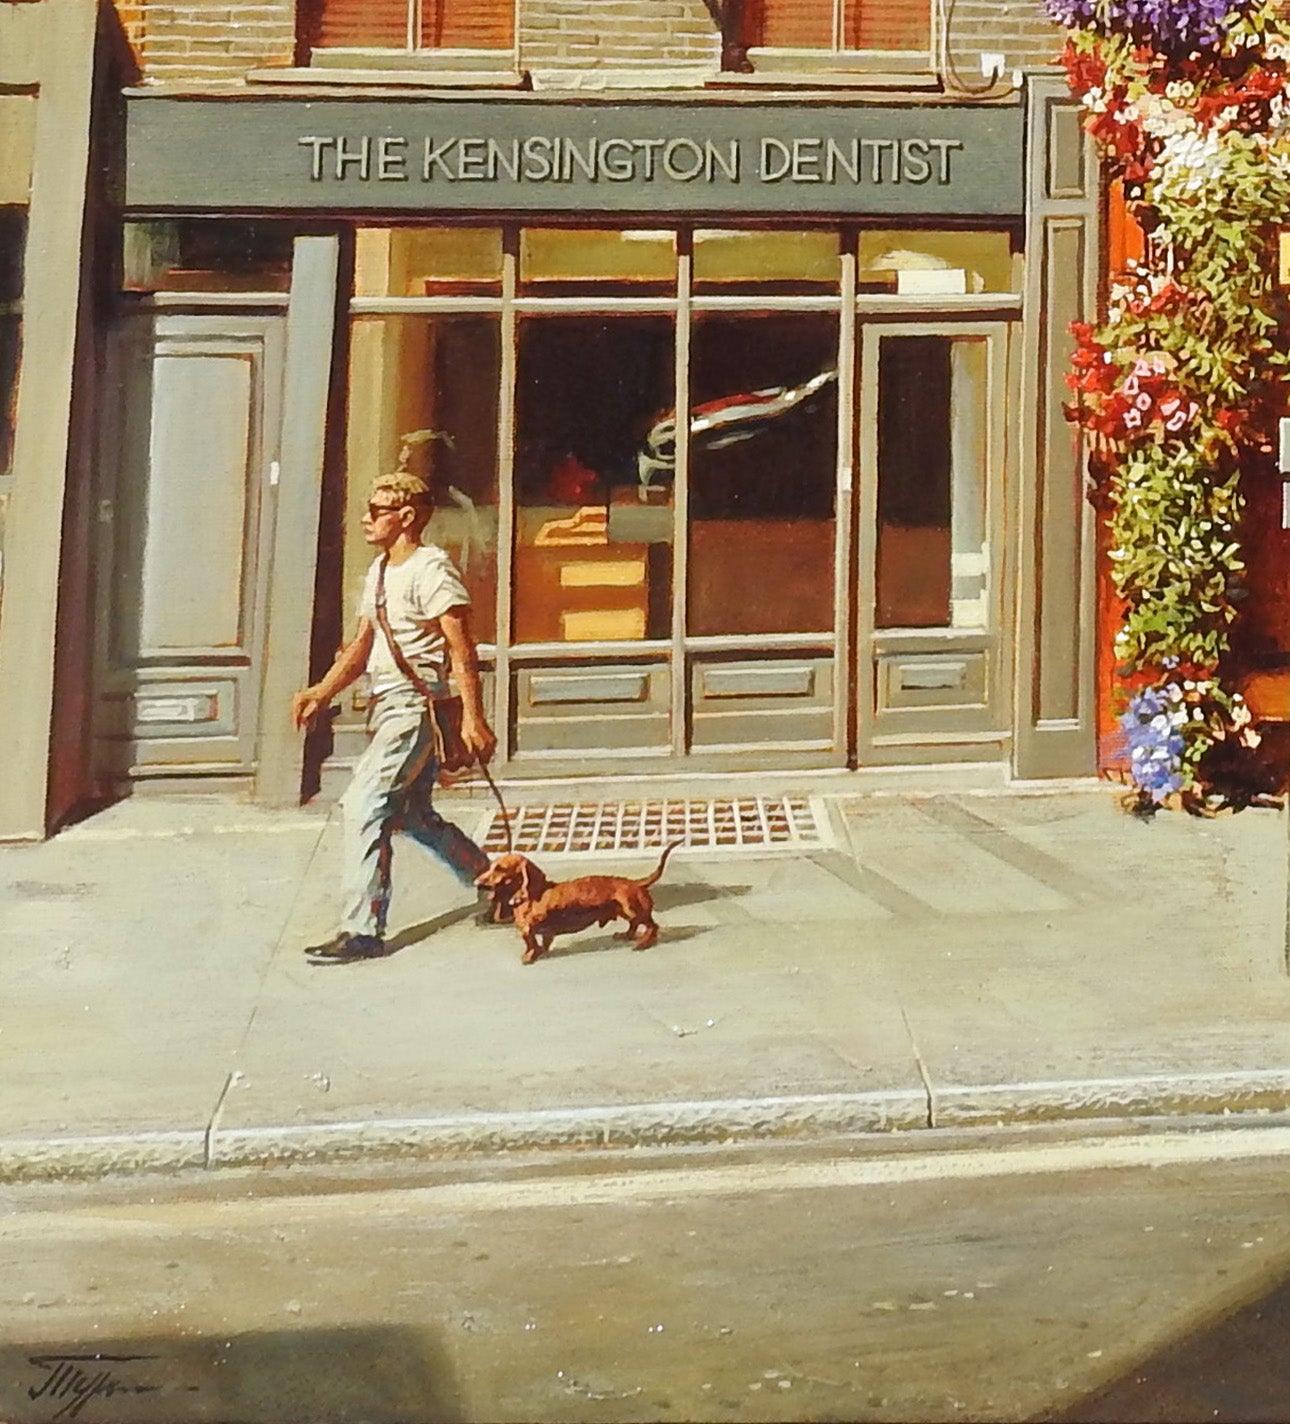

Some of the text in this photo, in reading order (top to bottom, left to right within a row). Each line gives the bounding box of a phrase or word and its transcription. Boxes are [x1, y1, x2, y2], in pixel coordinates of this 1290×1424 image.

[298, 136, 964, 185] THE KENSINGTON DENTIST
